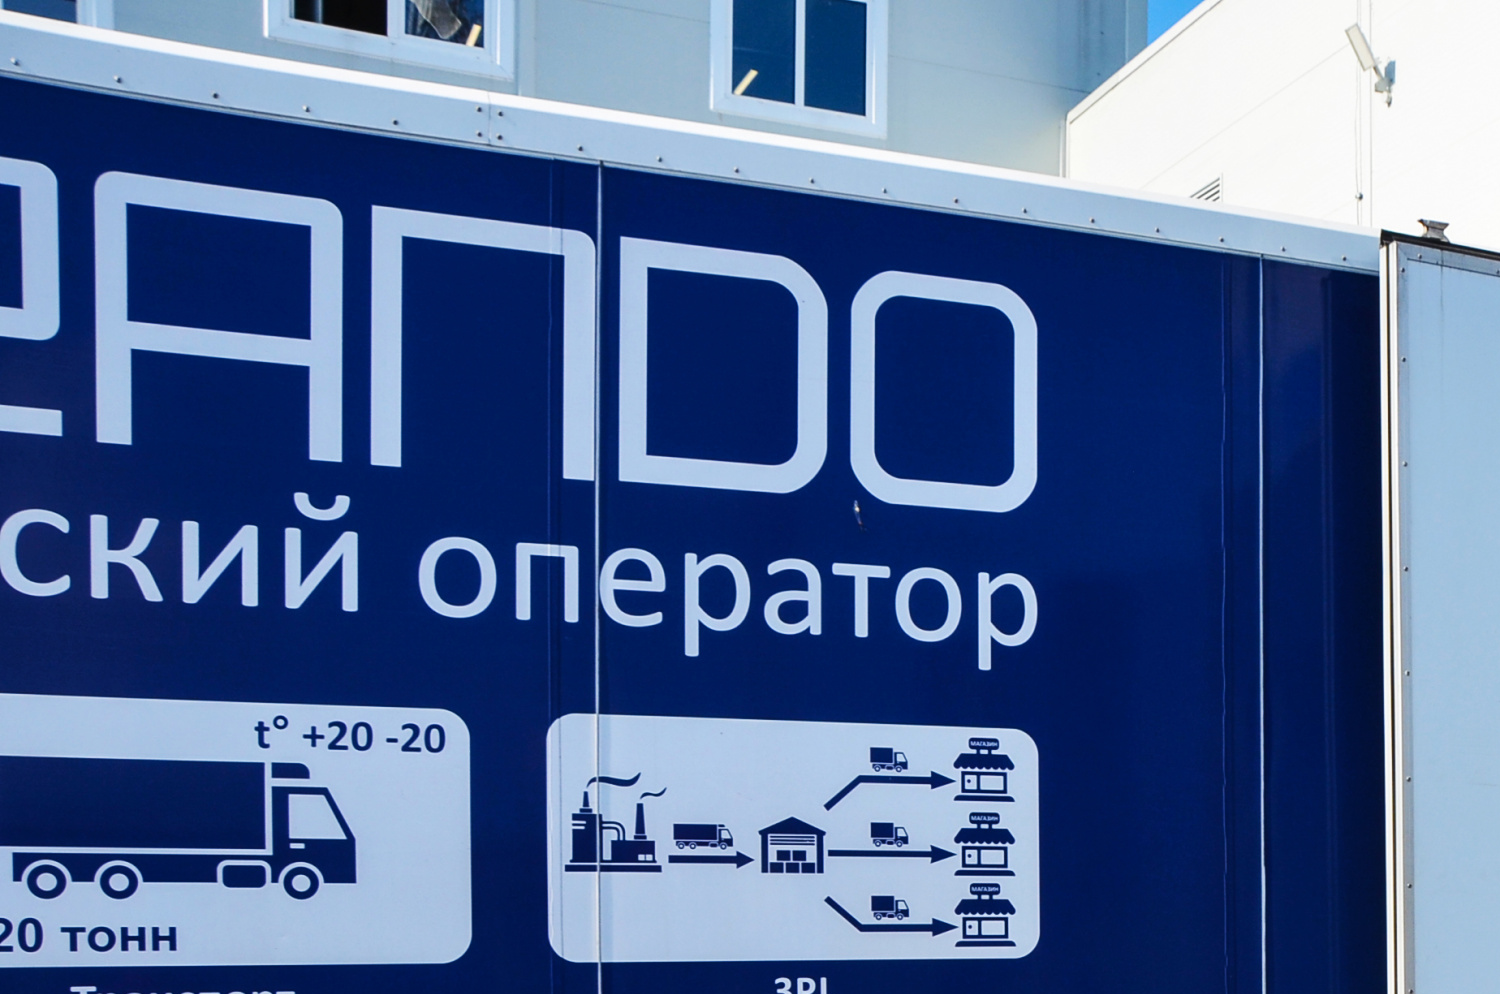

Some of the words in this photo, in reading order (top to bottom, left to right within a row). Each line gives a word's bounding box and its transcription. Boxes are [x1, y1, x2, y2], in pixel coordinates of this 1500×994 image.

[0, 156, 1037, 513] ANDO
[0, 491, 359, 613] ский
[418, 535, 1038, 671] оператор
[302, 721, 373, 751] +20
[385, 723, 447, 753] -20
[969, 740, 998, 748] МАГАЗИН
[970, 814, 999, 822] МАГАЗИН
[971, 885, 999, 893] МАГАЗИН
[60, 926, 178, 952] тонн
